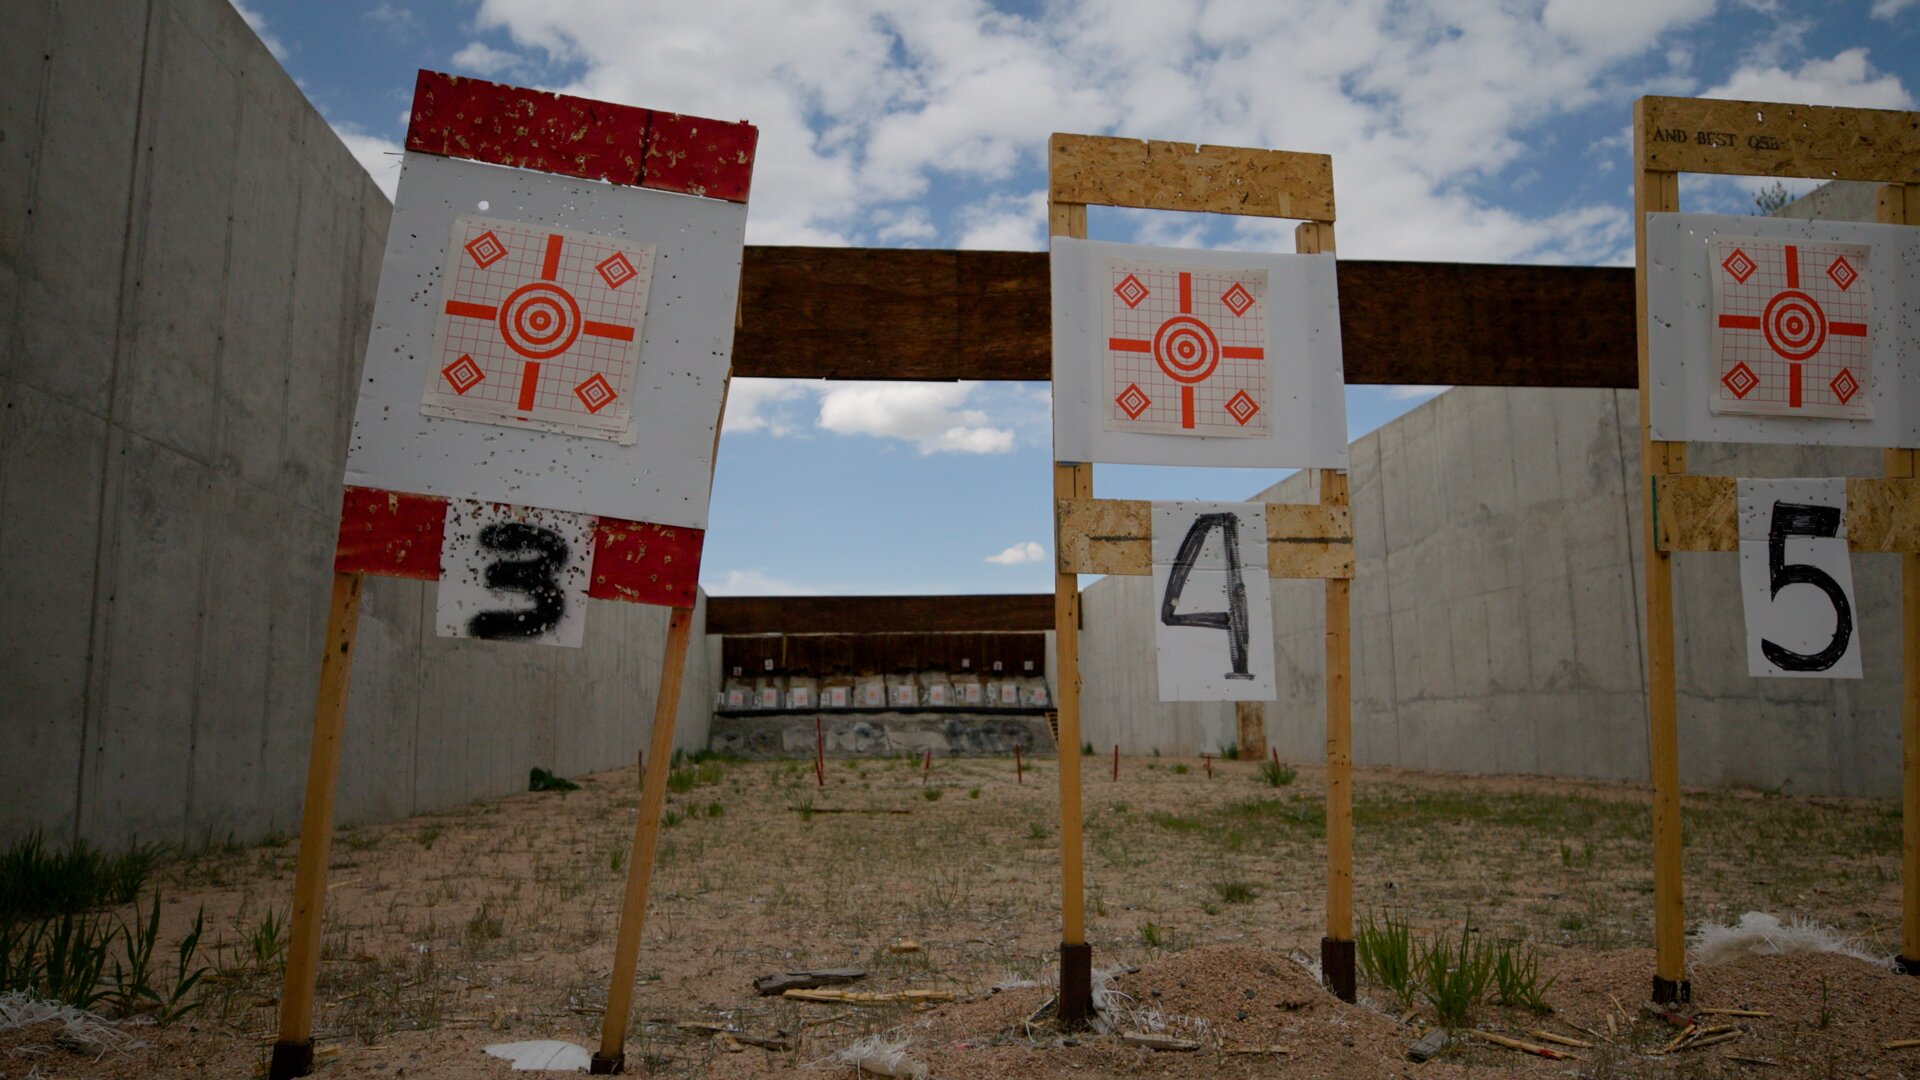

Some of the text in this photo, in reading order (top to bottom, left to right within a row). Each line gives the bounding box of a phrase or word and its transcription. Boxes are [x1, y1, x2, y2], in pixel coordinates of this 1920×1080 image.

[1653, 127, 1687, 143] AND
[1696, 131, 1737, 147] BEST
[467, 521, 568, 641] 3
[1161, 512, 1255, 680] 4
[1761, 500, 1853, 671] 5
